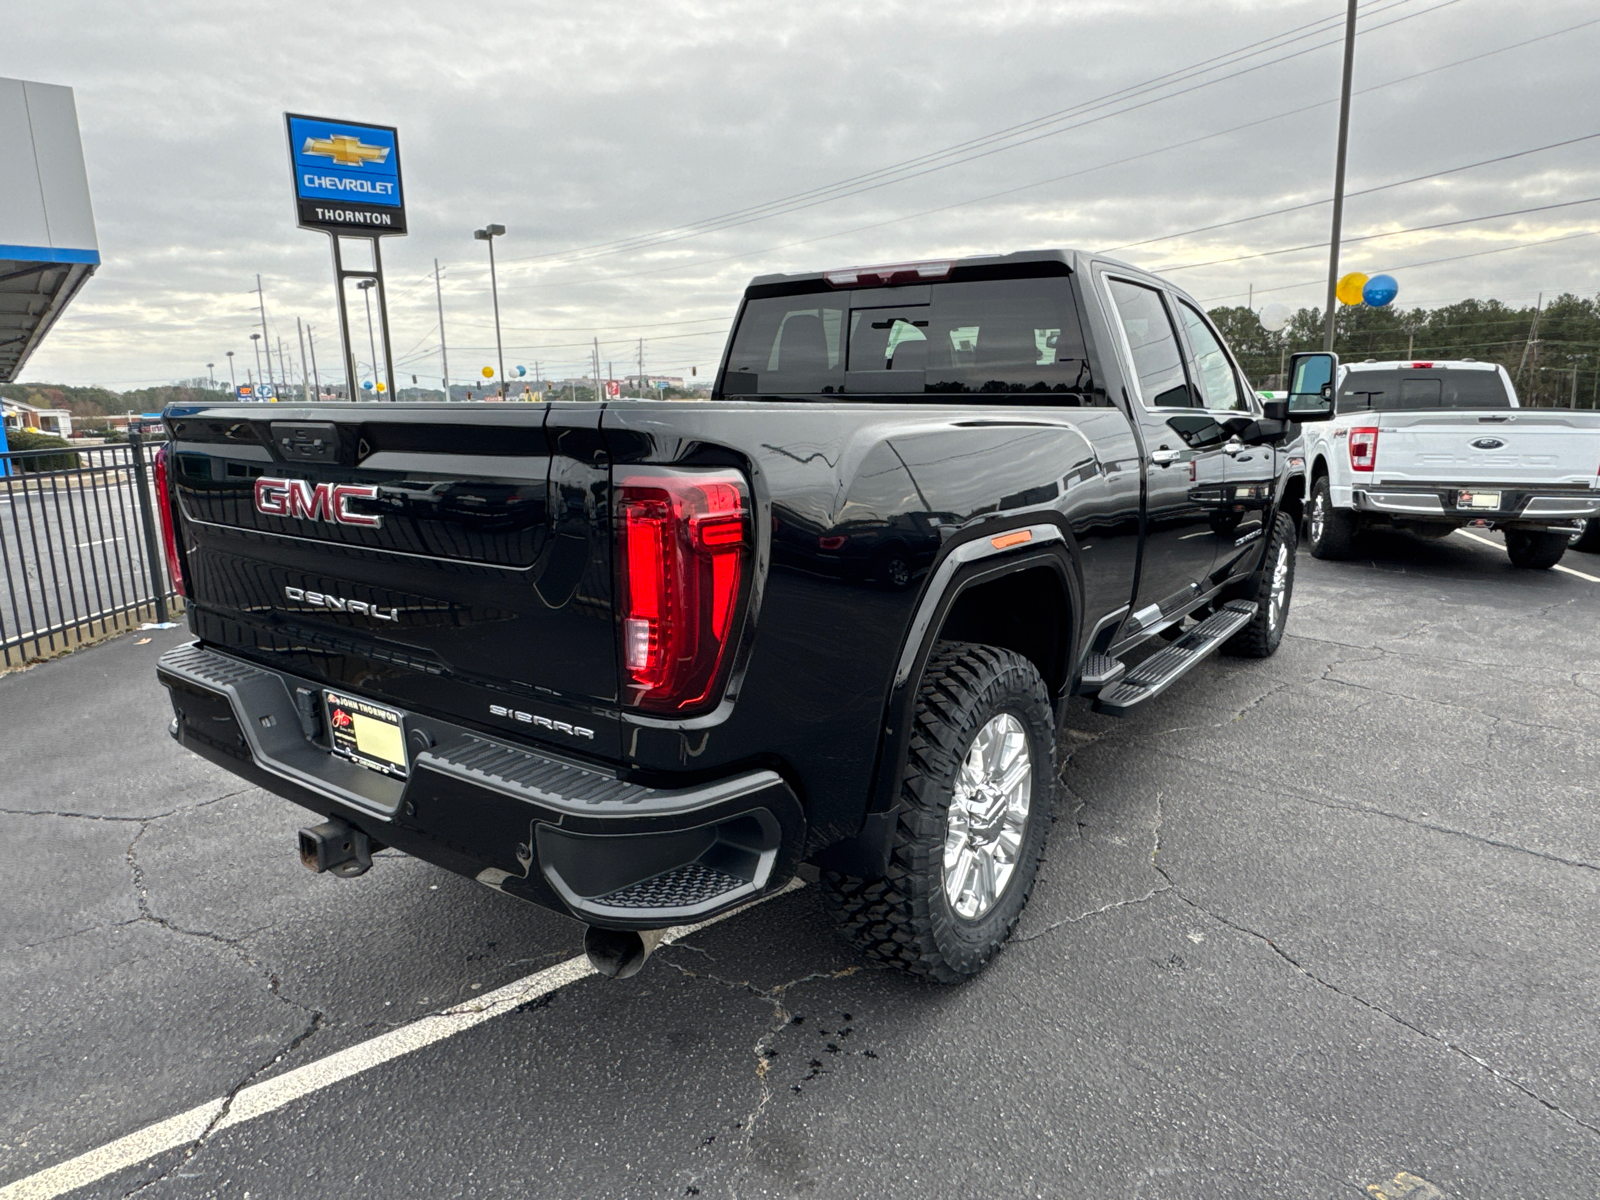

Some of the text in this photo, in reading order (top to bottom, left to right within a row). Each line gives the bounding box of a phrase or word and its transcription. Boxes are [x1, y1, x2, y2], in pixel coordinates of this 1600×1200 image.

[303, 174, 394, 195] CHEVROLET
[315, 208, 391, 225] THORNTON
[254, 476, 384, 530] GMC
[285, 586, 399, 622] DENALI
[489, 704, 595, 740] SIERRA
